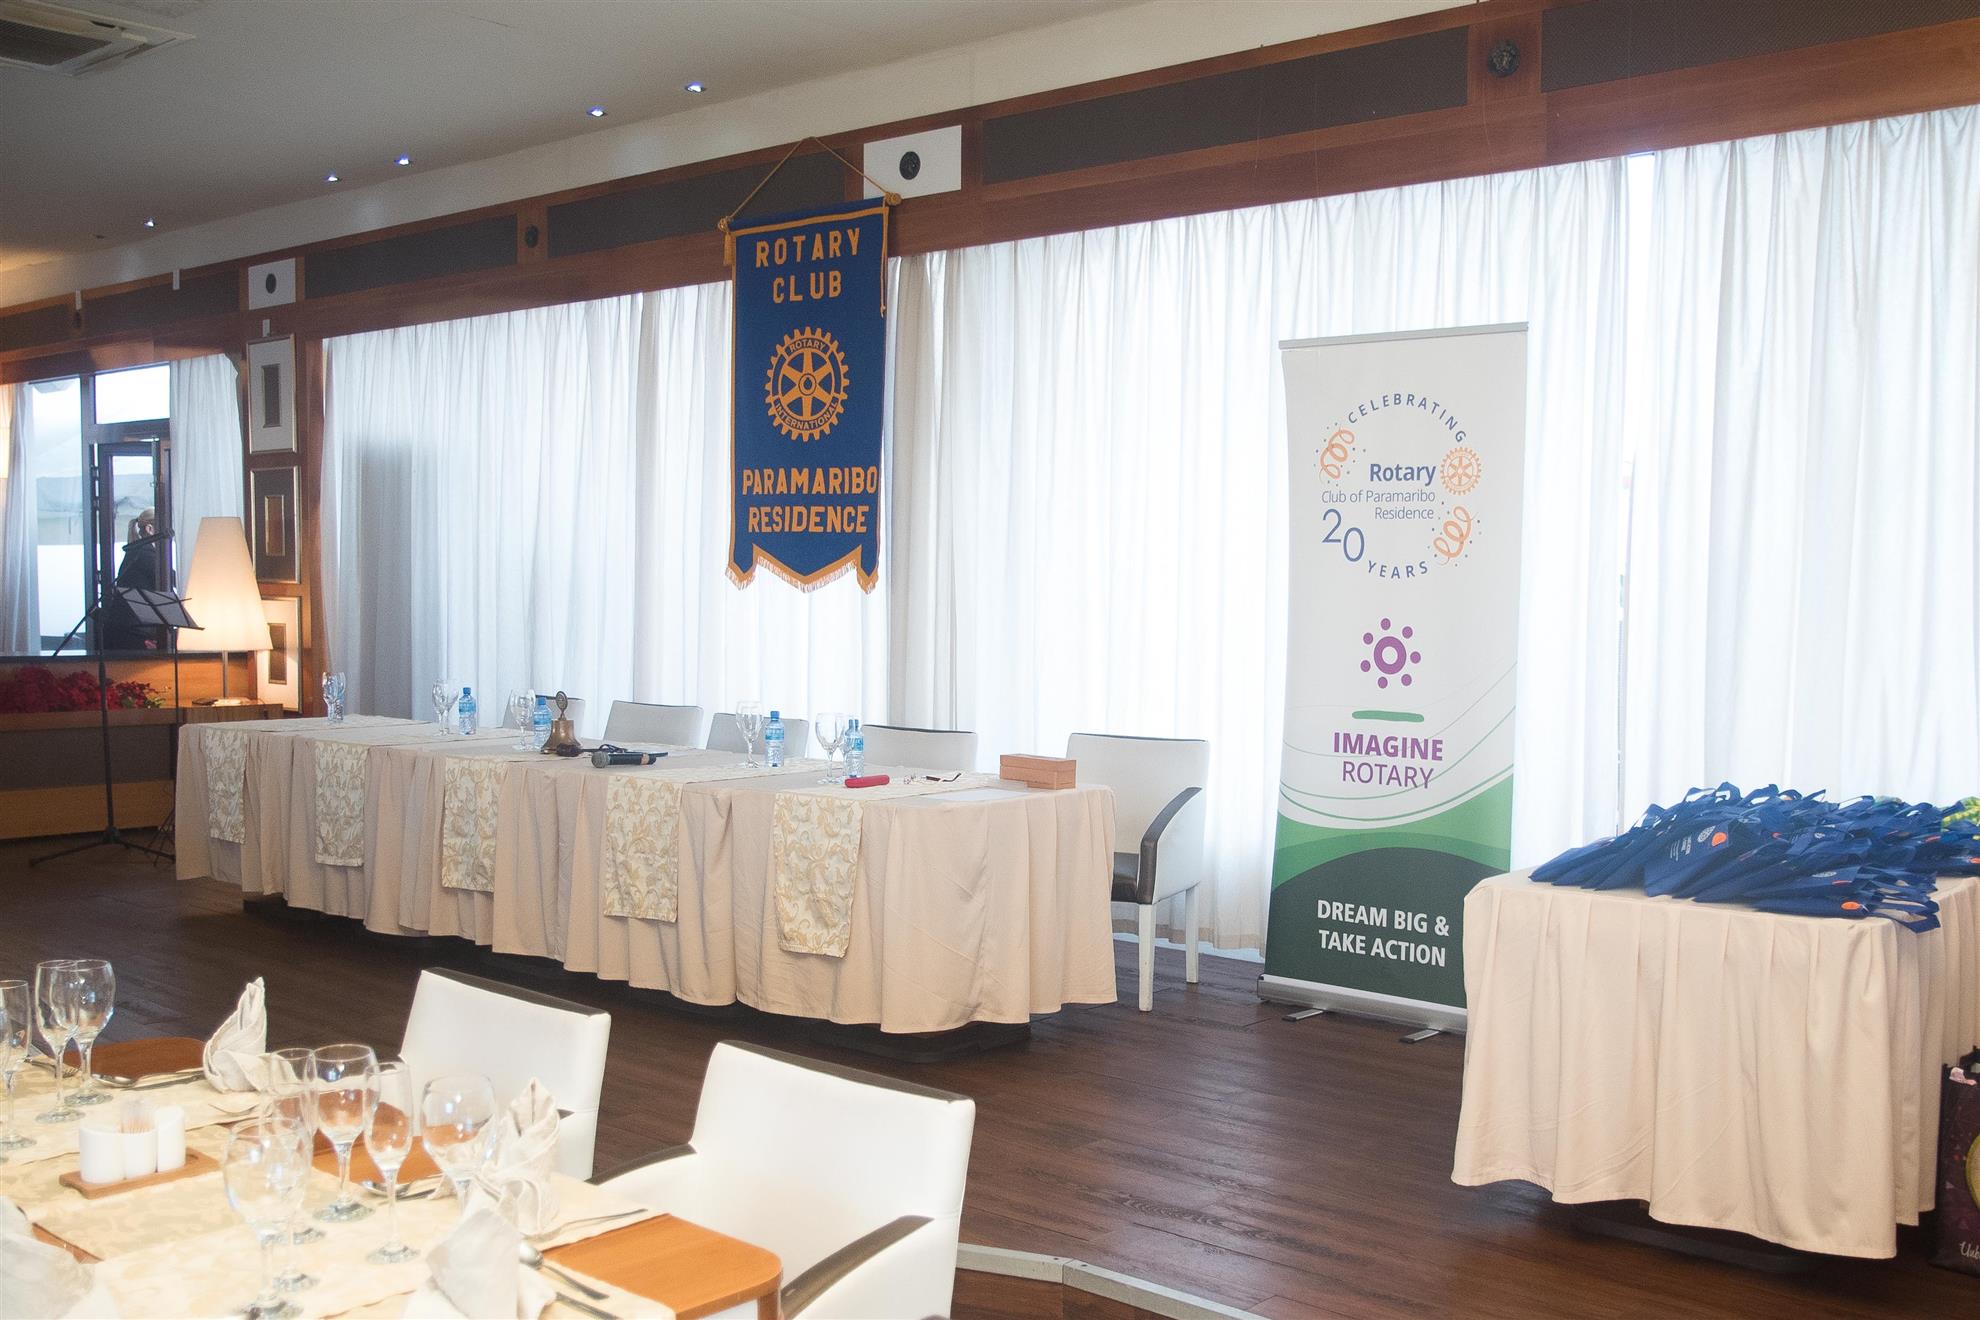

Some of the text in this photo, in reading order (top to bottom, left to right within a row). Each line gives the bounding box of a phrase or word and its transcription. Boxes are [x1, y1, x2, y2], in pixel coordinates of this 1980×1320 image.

[755, 227, 860, 268] ROTARY
[772, 270, 842, 304] CLUB
[789, 339, 826, 352] ROTARY
[775, 401, 838, 430] INTERNATIONAL
[1348, 393, 1467, 443] CELEBRATING
[742, 466, 878, 496] PARAMARIBO
[1369, 463, 1436, 486] Rotary
[1321, 489, 1436, 504] Club of Paramaribo
[748, 505, 869, 533] RESIDENCE
[1374, 506, 1434, 520] Residence
[1322, 508, 1428, 579] 20 YEARS
[1333, 732, 1443, 761] IMAGINE
[1342, 761, 1434, 789] ROTARY
[1317, 900, 1450, 937] DREAM BIG &
[1319, 929, 1446, 967] TAKE ACTION
